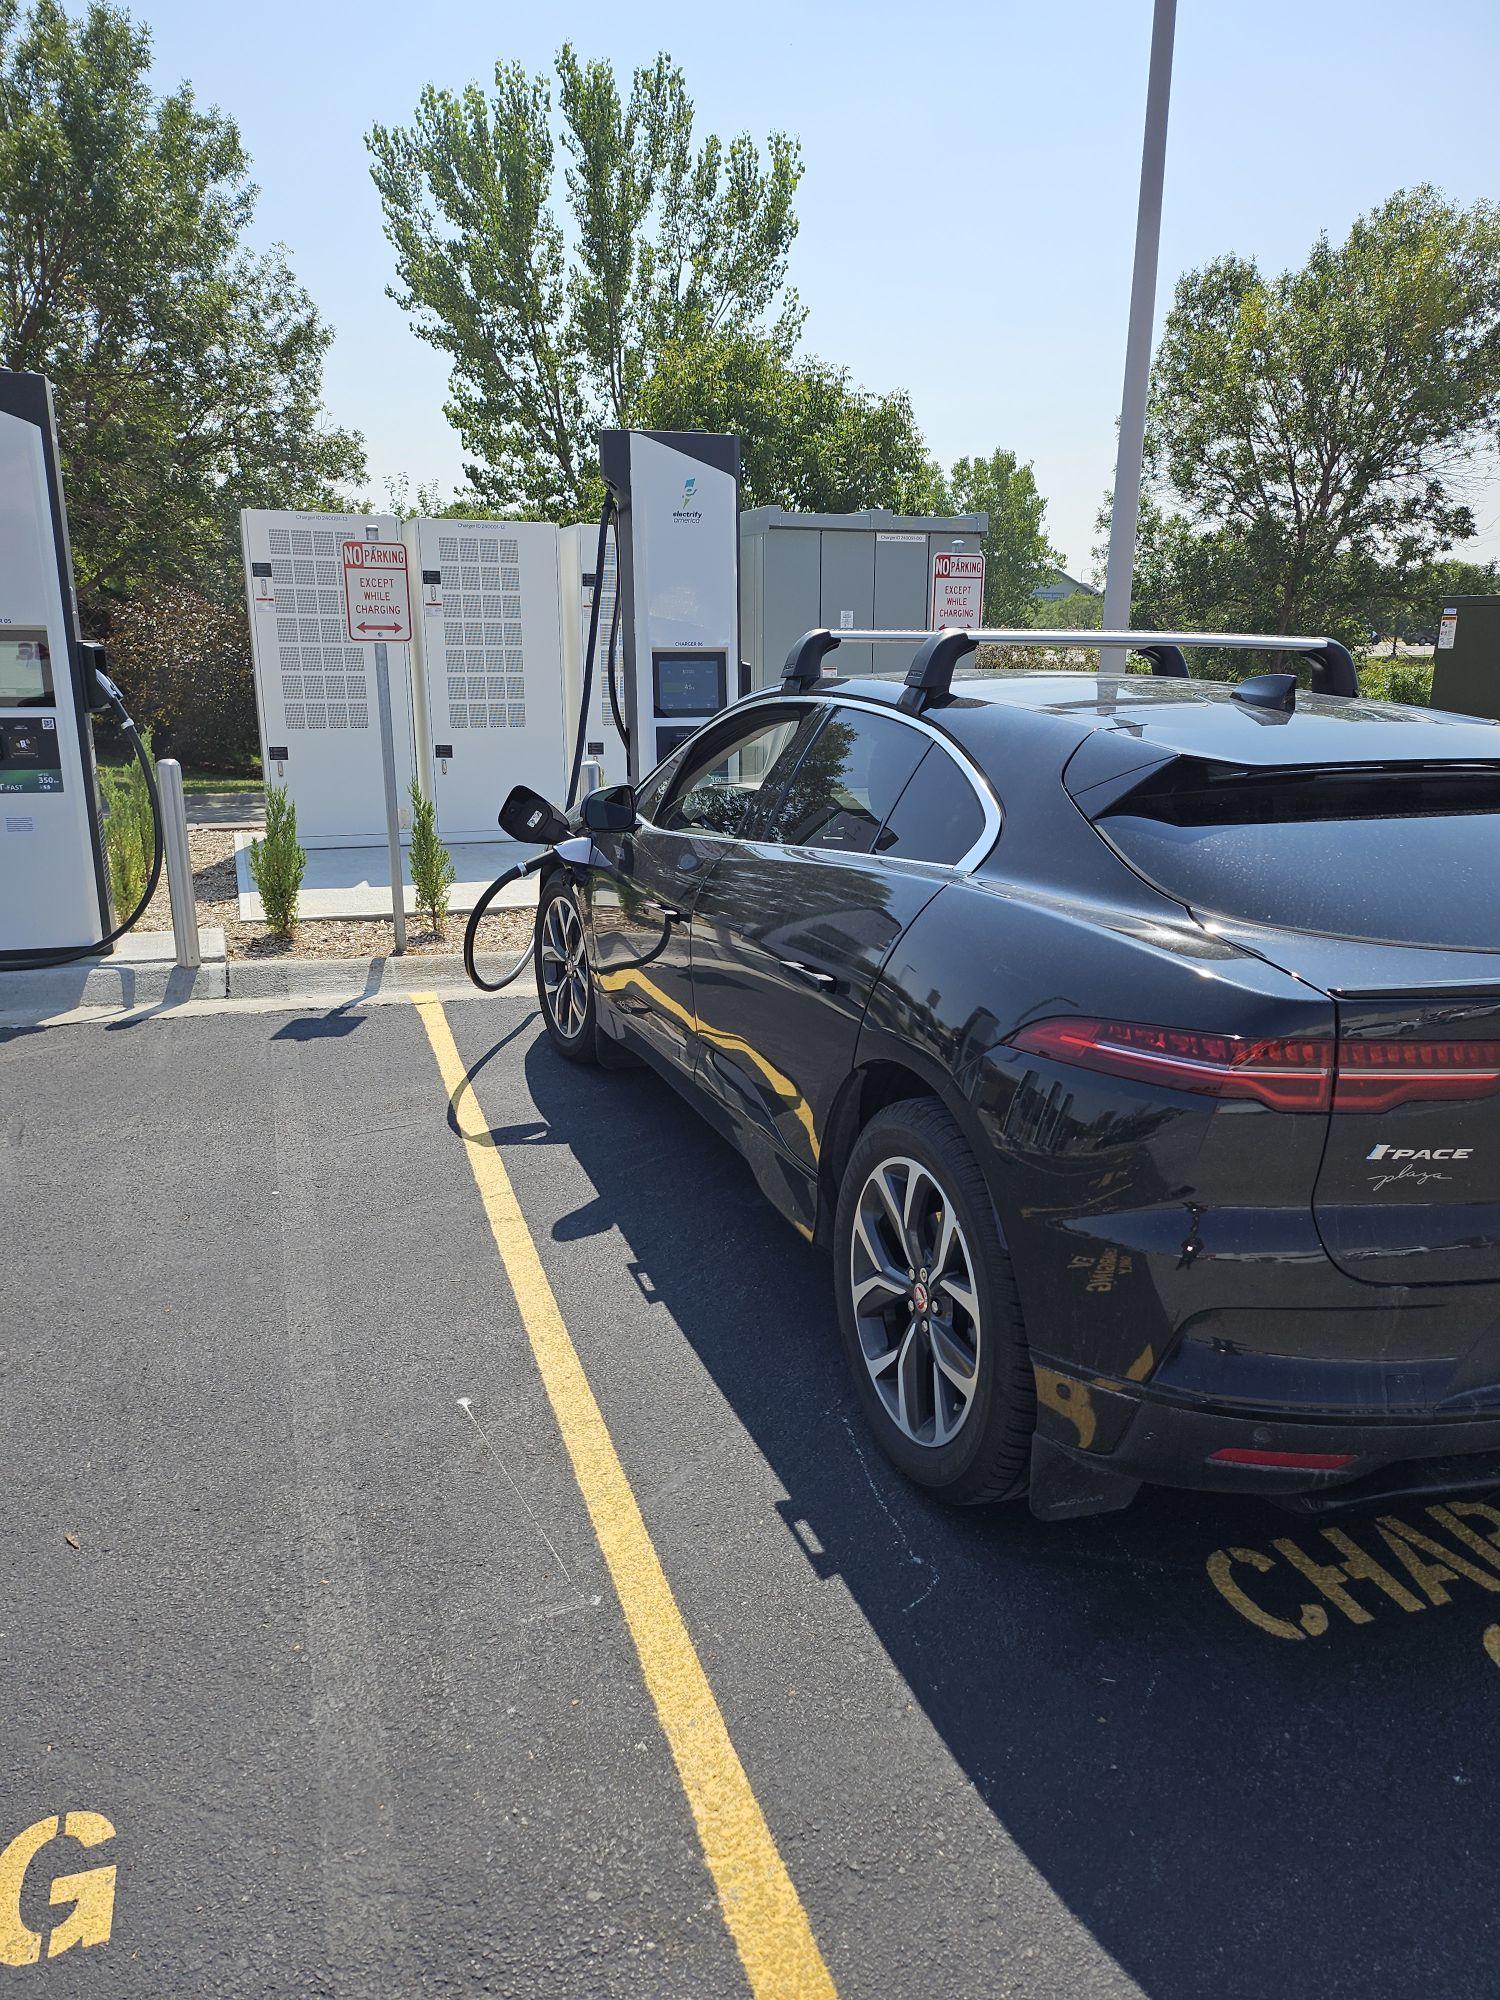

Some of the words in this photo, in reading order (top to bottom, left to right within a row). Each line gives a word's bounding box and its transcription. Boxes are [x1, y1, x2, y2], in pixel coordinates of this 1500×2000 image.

[672, 510, 703, 519] electrify
[343, 545, 363, 566] NO
[364, 549, 404, 564] PARKING
[935, 558, 950, 575] NO
[950, 561, 982, 573] PARKING
[359, 577, 394, 588] EXCEPT
[944, 585, 972, 595] EXCEPT
[363, 591, 391, 601] WHILE
[946, 597, 967, 606] WHILE
[355, 604, 401, 615] CHARGING
[939, 609, 974, 618] CHARGING
[38, 776, 54, 784] 350
[1366, 1143, 1475, 1160] I-PACE
[1367, 1163, 1453, 1191] plaza
[0, 1811, 117, 1966] G
